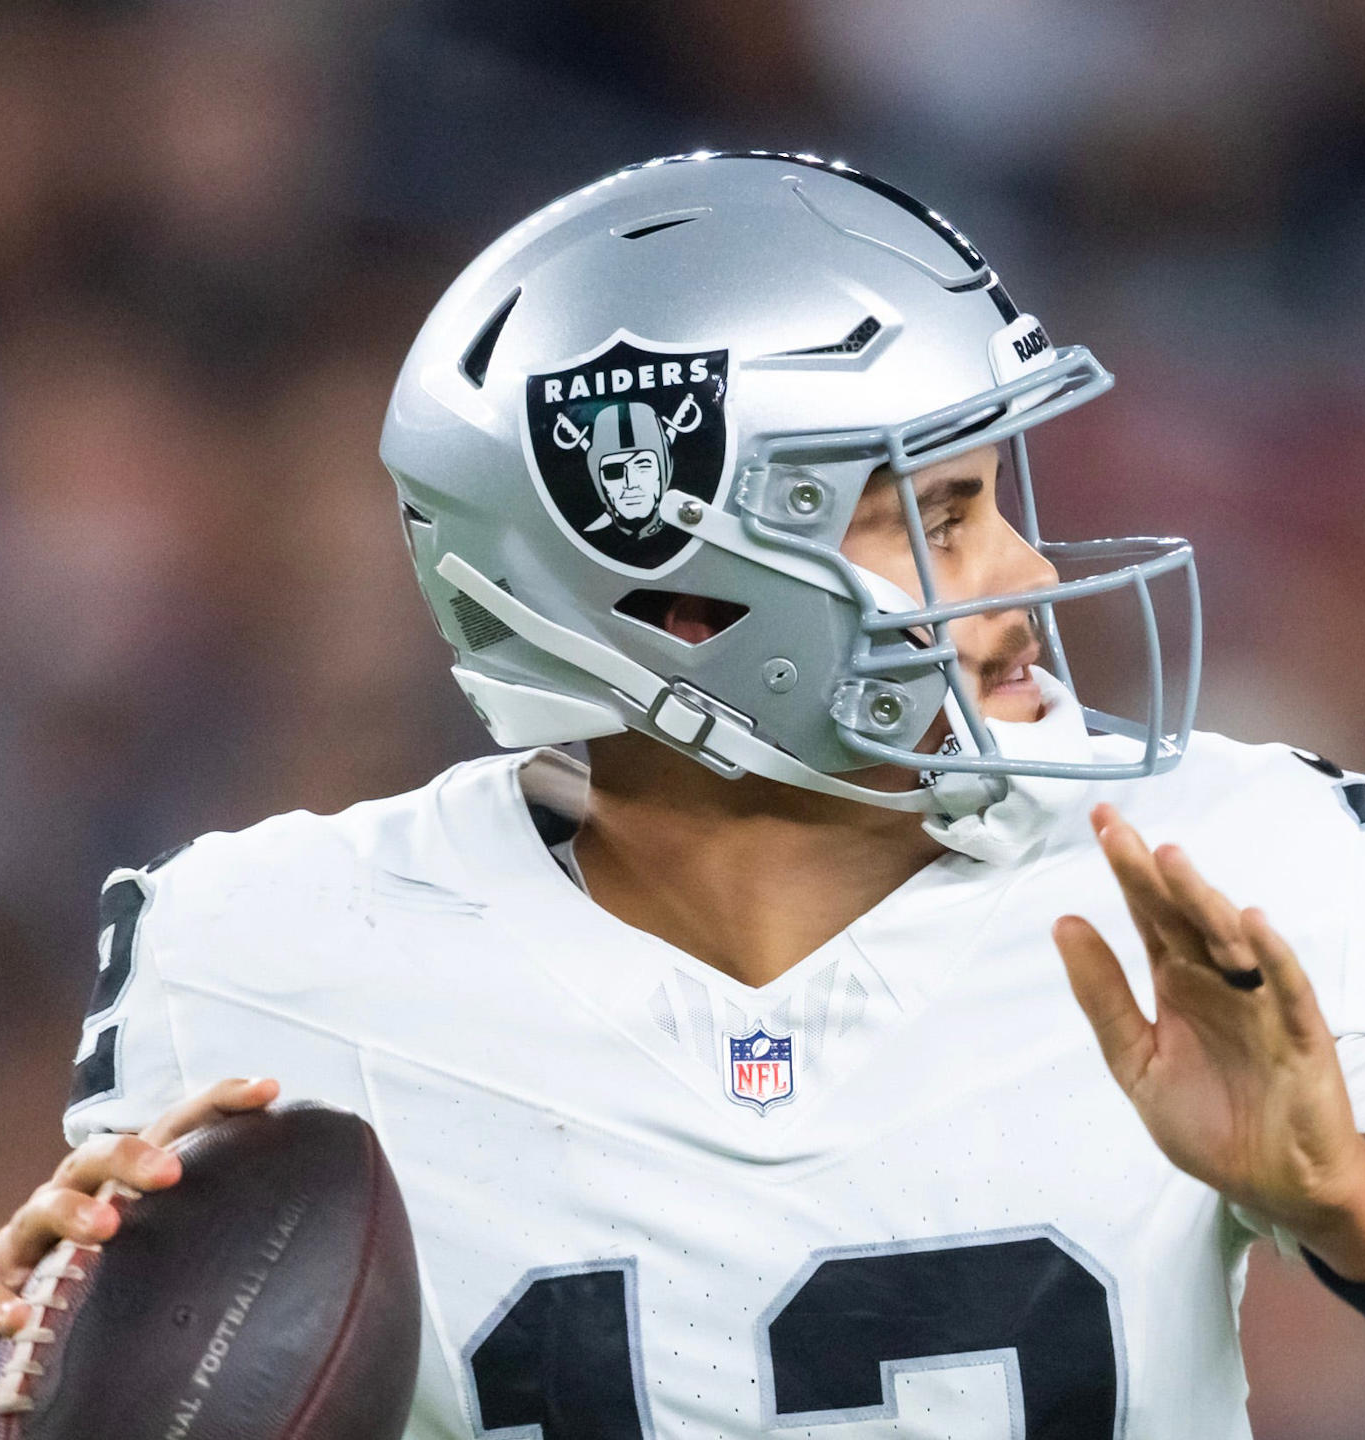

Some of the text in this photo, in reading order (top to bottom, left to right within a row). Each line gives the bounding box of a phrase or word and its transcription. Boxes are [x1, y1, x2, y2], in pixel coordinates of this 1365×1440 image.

[544, 358, 708, 404] RAIDERS
[735, 1063, 787, 1097] NFL
[191, 1265, 269, 1390] FOOTBALL
